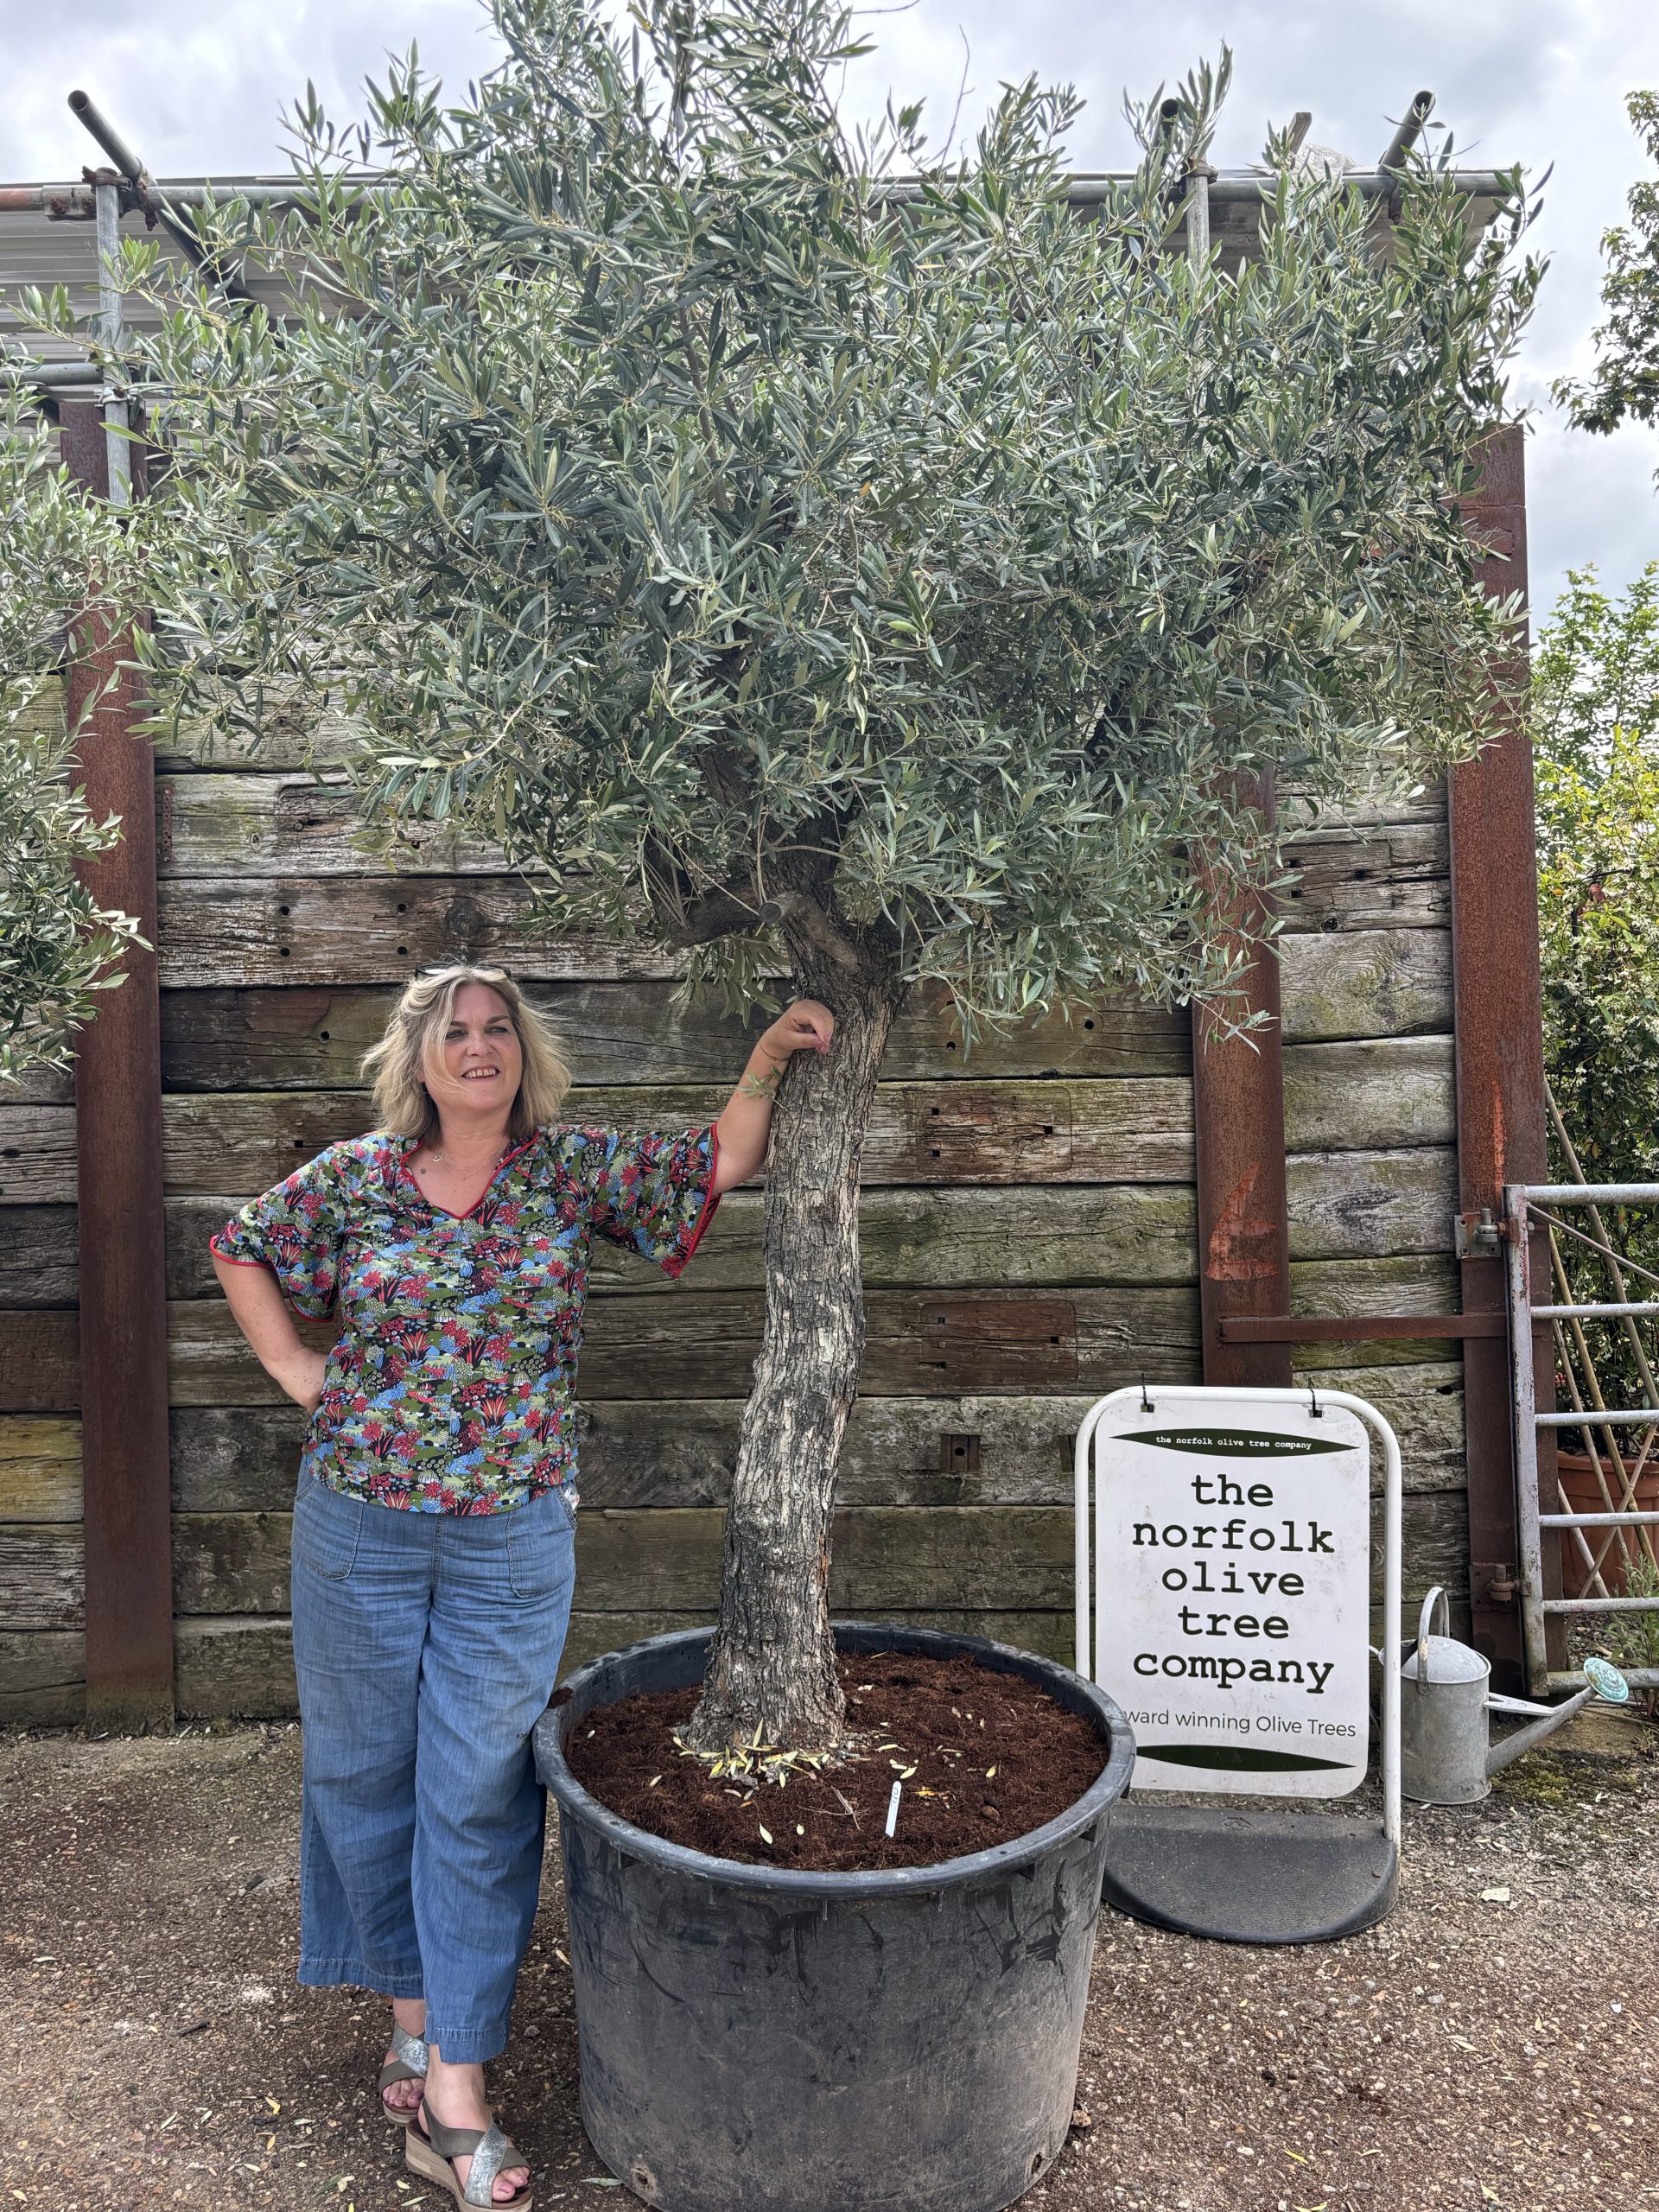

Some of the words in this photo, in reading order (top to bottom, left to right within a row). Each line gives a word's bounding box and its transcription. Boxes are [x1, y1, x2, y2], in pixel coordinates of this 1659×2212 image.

[1176, 1437, 1213, 1446] norfolk
[1217, 1438, 1244, 1446] olive
[1274, 1440, 1312, 1451] company
[1192, 1474, 1274, 1506] the
[1132, 1519, 1335, 1553] norfolk
[1162, 1561, 1305, 1596] olive
[1178, 1605, 1289, 1638] tree
[1134, 1653, 1335, 1694] company
[1124, 1709, 1169, 1726] ward
[1175, 1711, 1250, 1733] winning
[1256, 1715, 1302, 1734] Olive
[1307, 1719, 1356, 1737] Trees
